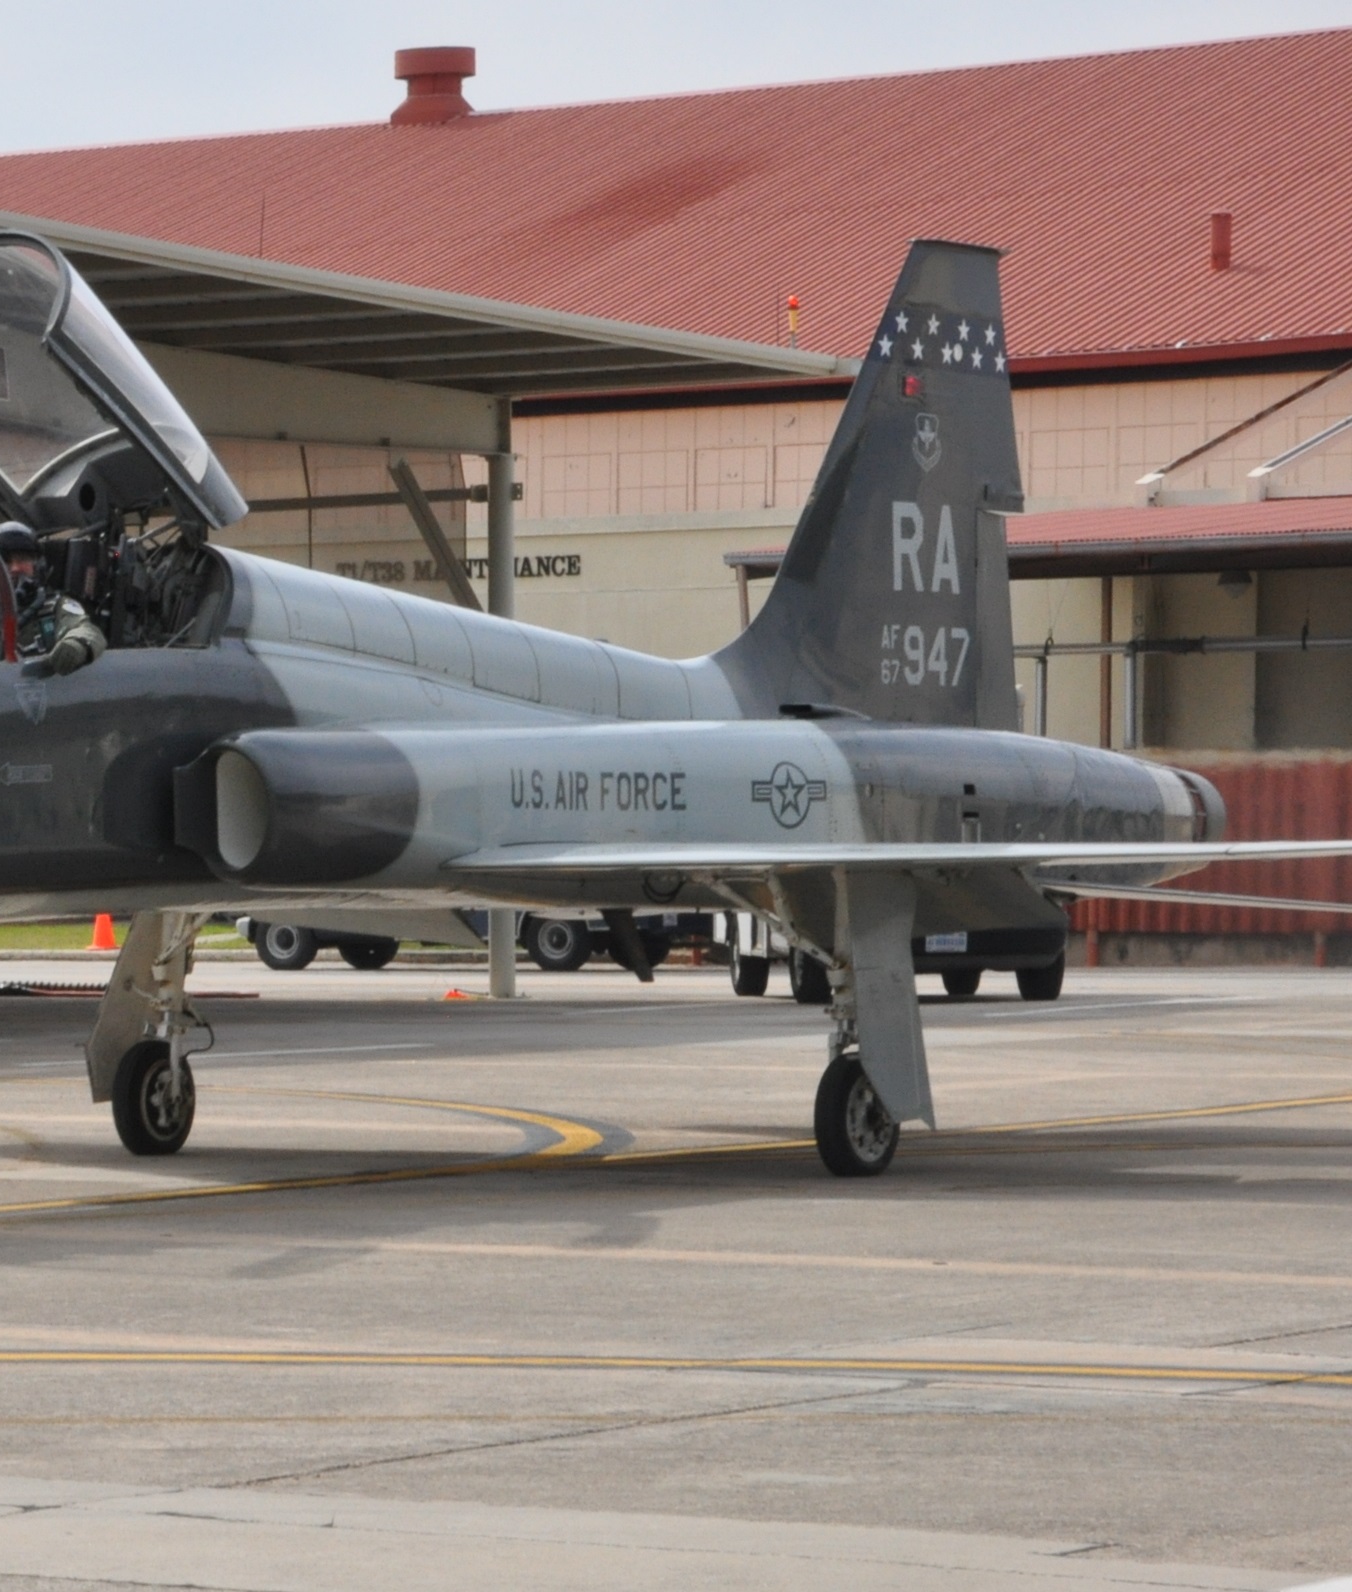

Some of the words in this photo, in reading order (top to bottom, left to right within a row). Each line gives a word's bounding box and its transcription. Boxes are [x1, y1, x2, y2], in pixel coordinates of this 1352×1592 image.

[892, 501, 960, 595] RA
[881, 624, 900, 649] AF
[903, 625, 970, 686] 947
[880, 659, 900, 685] 67
[510, 769, 548, 809] U.S.
[554, 771, 589, 810] AIR
[600, 771, 686, 811] FORCE
